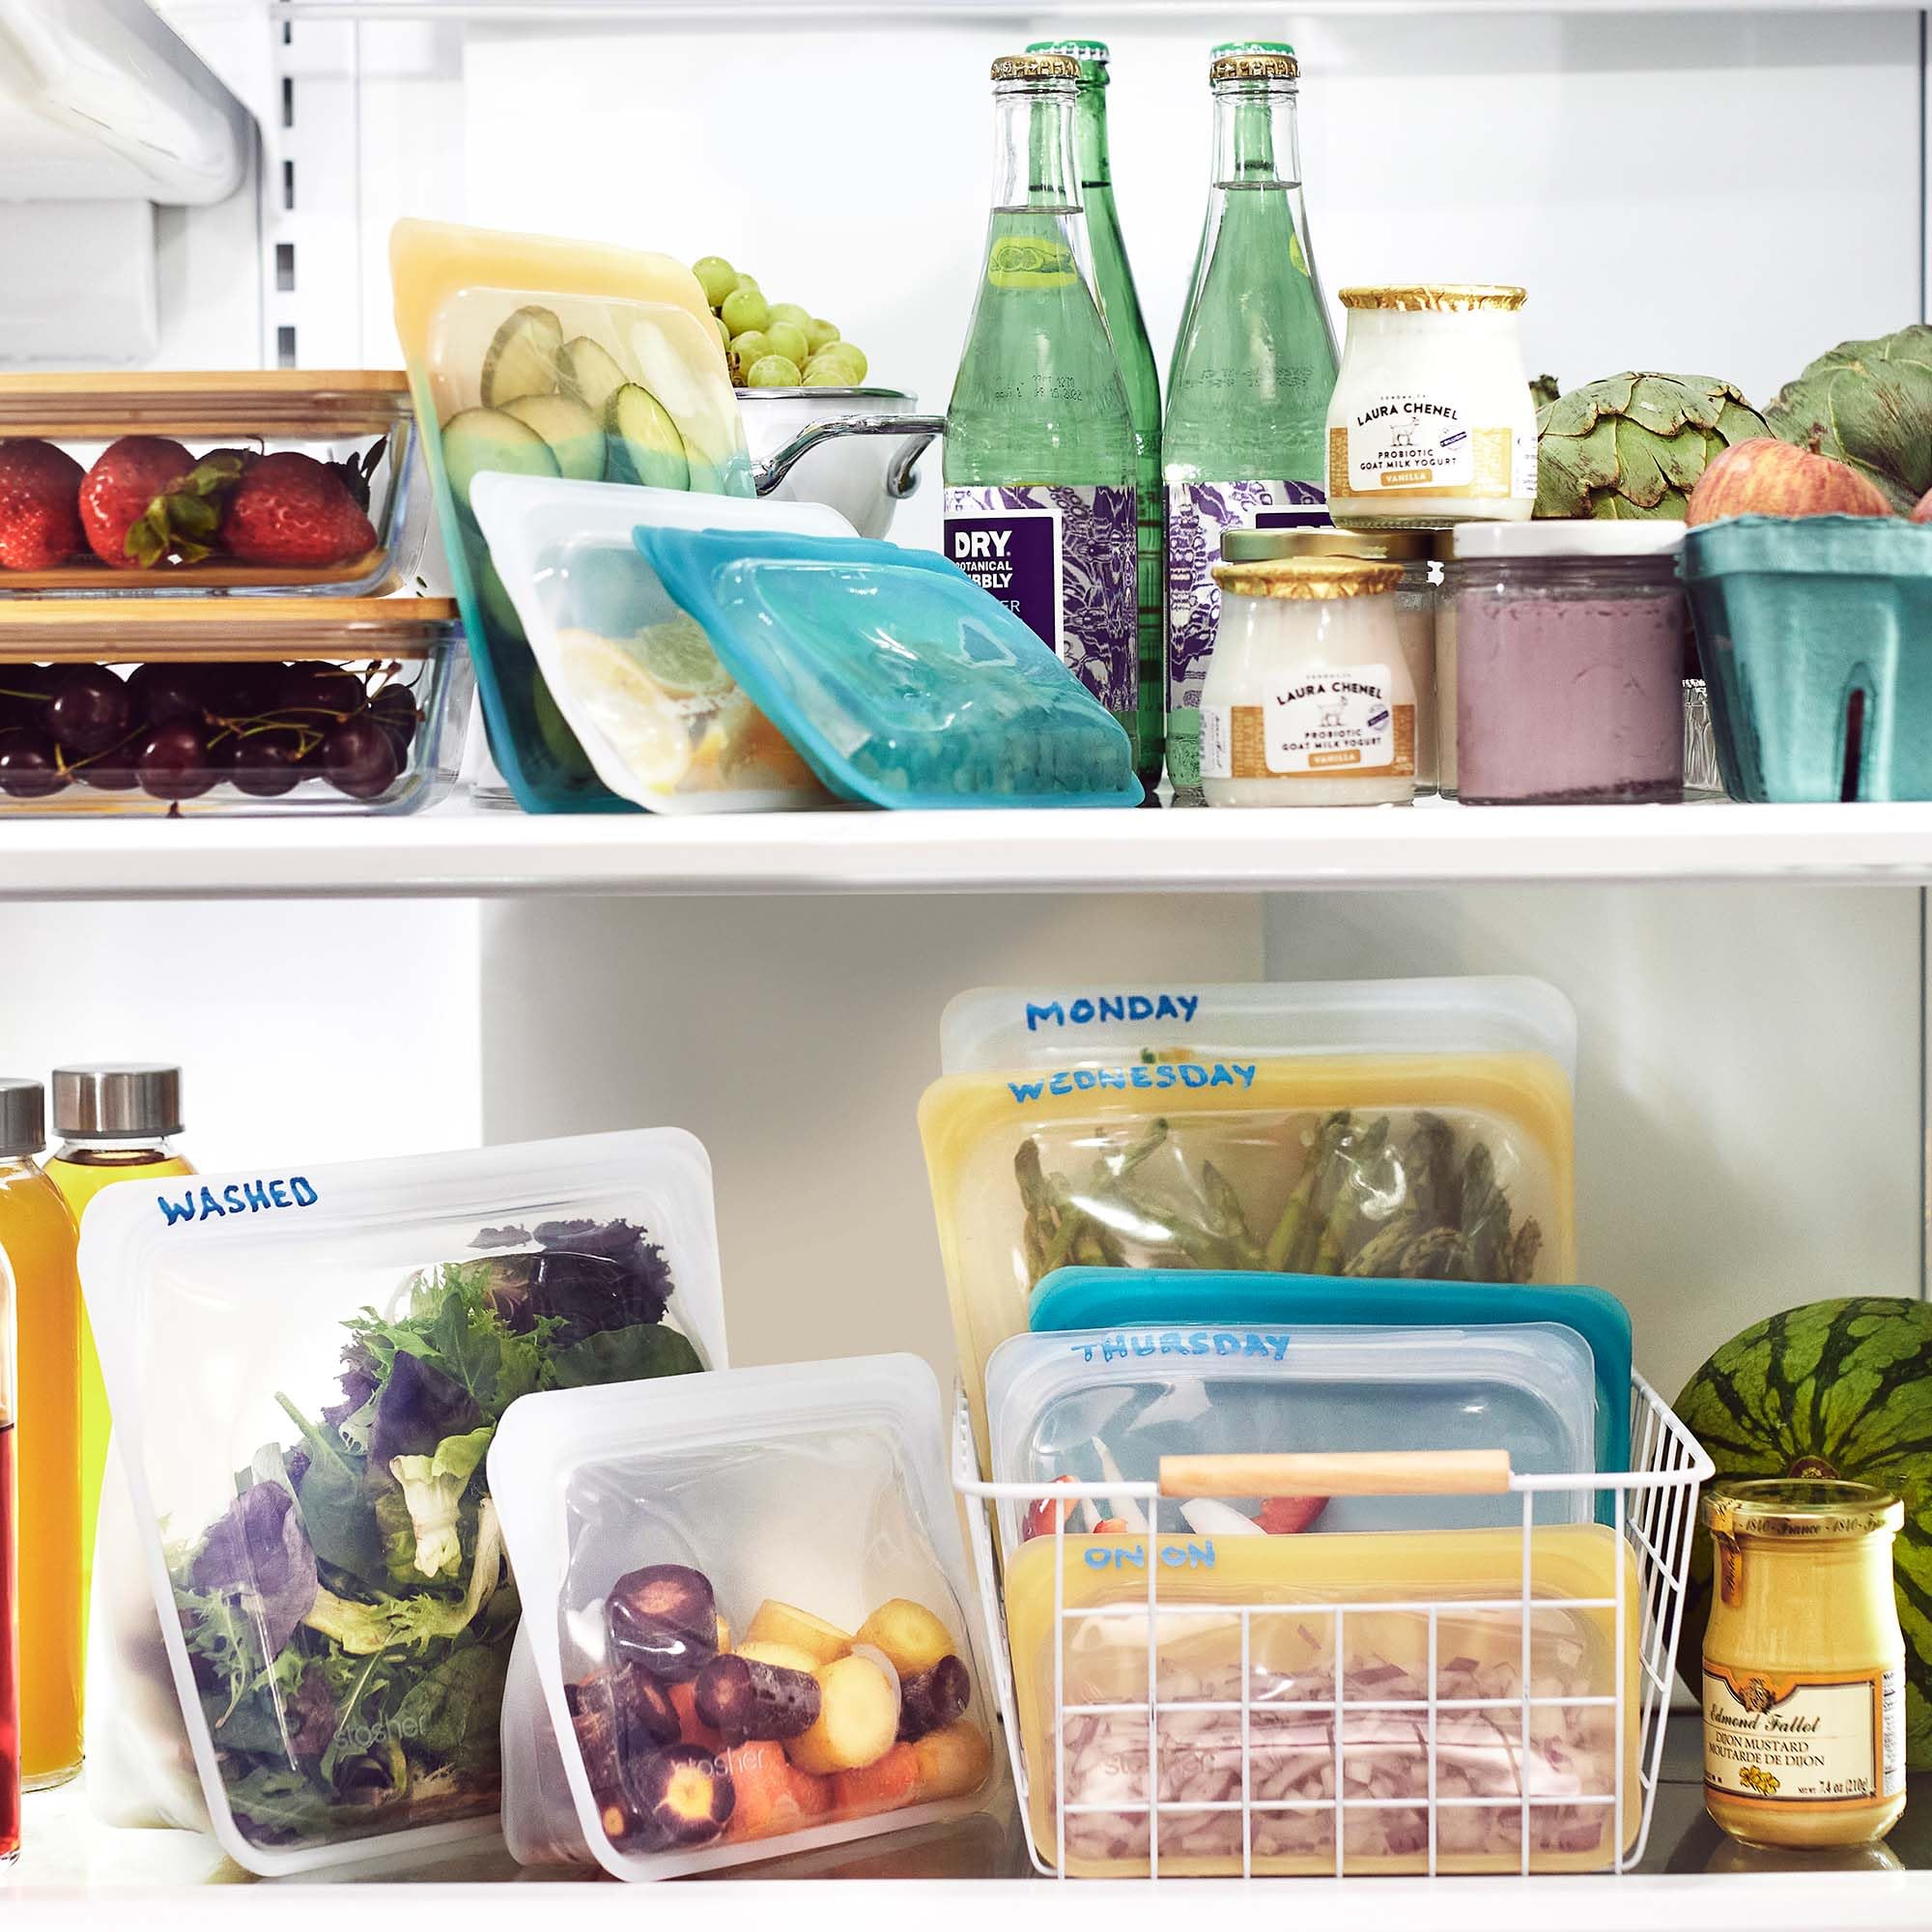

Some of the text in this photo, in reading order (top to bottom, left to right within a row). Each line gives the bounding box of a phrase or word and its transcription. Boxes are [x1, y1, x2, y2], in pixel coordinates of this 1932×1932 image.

[1357, 403, 1458, 426] LAURA CHENEL
[1360, 462, 1382, 470] GOAT
[1415, 458, 1457, 467] YOGURT
[1378, 449, 1434, 459] PROBIOTIC
[968, 573, 1013, 588] BBLY
[1277, 682, 1381, 705] LAURA CHENEL
[1282, 742, 1310, 752] GOAT
[1345, 737, 1381, 747] YOGURT
[1305, 729, 1361, 739] PROBIOTIC
[1026, 995, 1198, 1031] MONDAY
[1008, 1065, 1256, 1103] WEDNESDAY
[157, 1177, 318, 1226] WASHED
[1071, 1332, 1291, 1362] THURSDAY
[1084, 1540, 1215, 1570] ONON
[1710, 1703, 1760, 1729] Edmond
[1709, 1743, 1824, 1768] MOUTARDE DE DIJON
[1745, 1738, 1808, 1752] MUSTARD
